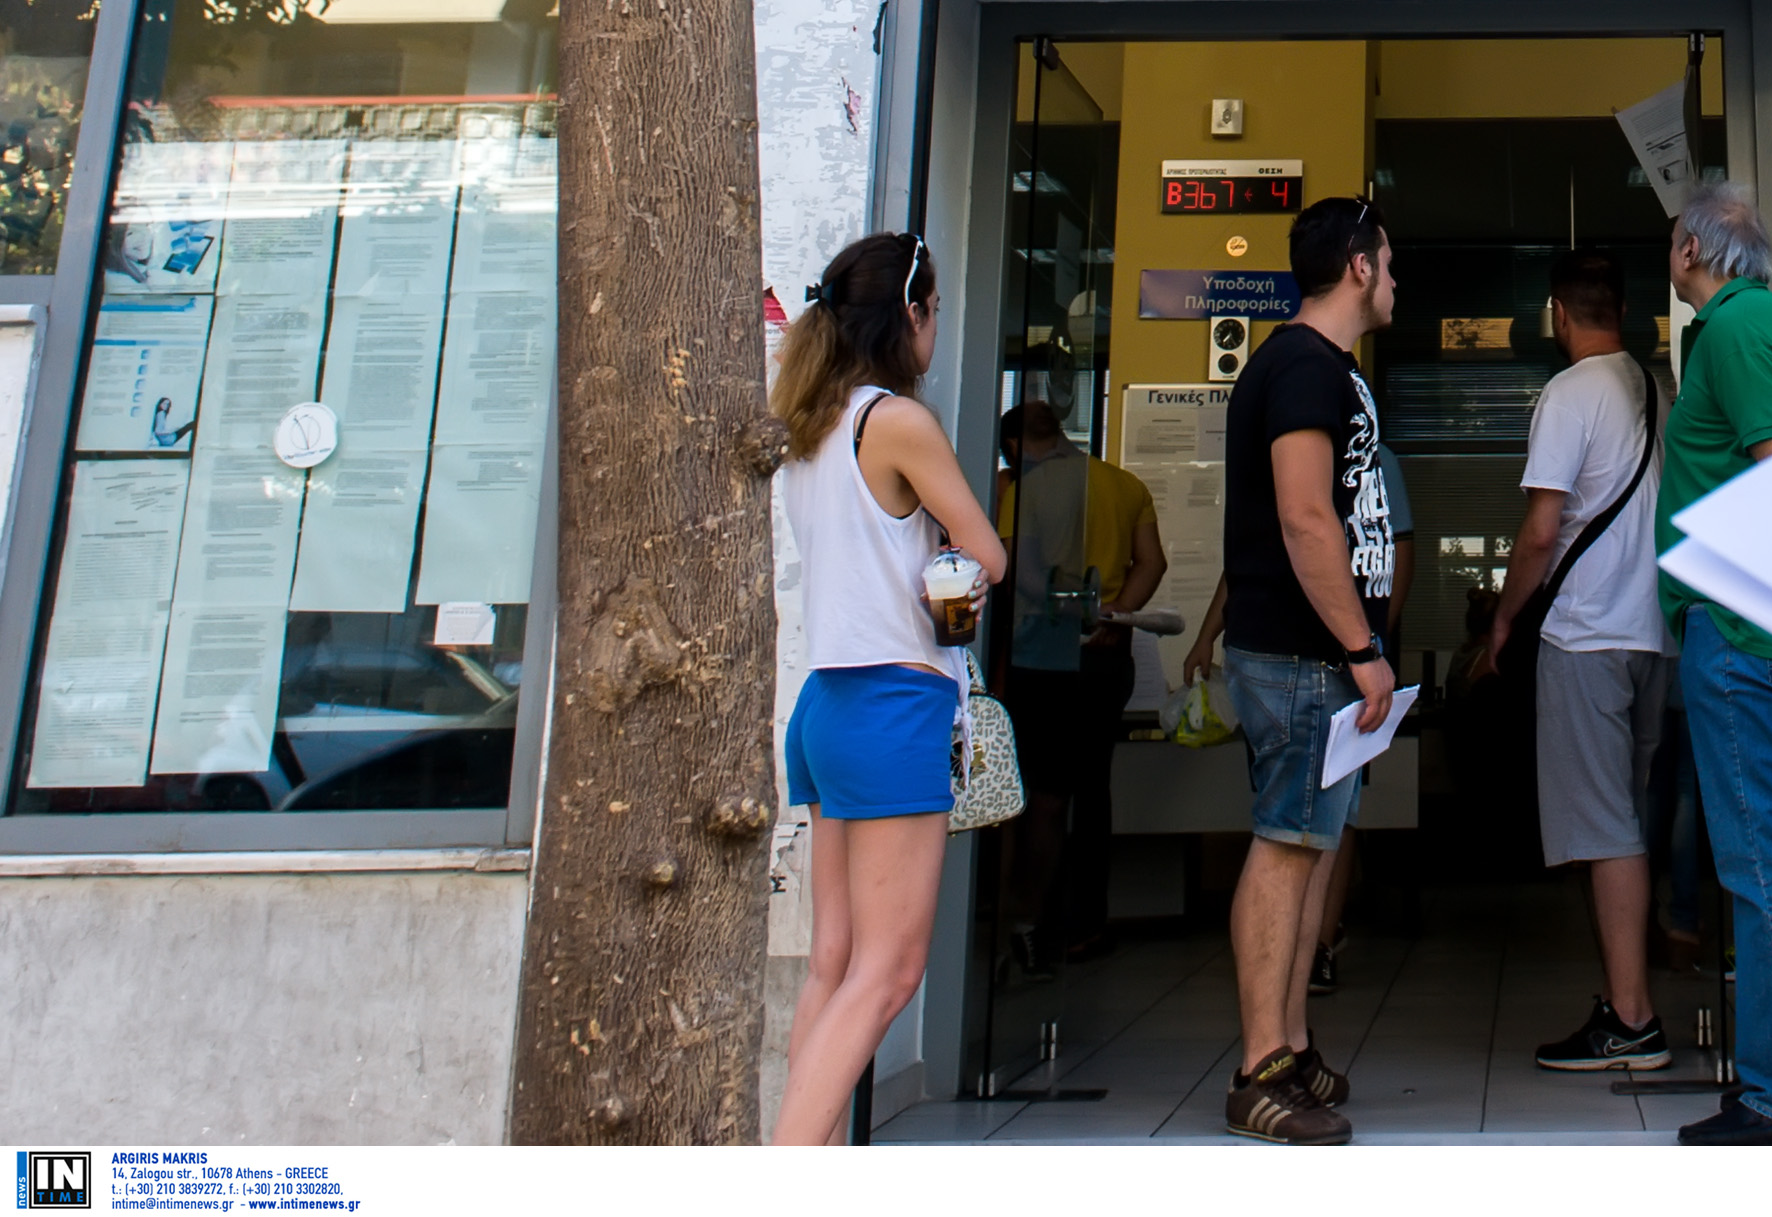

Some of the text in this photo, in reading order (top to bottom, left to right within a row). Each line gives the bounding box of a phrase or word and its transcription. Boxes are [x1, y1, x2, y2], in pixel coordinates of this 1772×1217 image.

[1271, 181, 1288, 208] 4
[1202, 276, 1275, 293] Υποδοχή
[1184, 295, 1290, 313] Πληροφορίες
[1148, 389, 1204, 406] Γενικές
